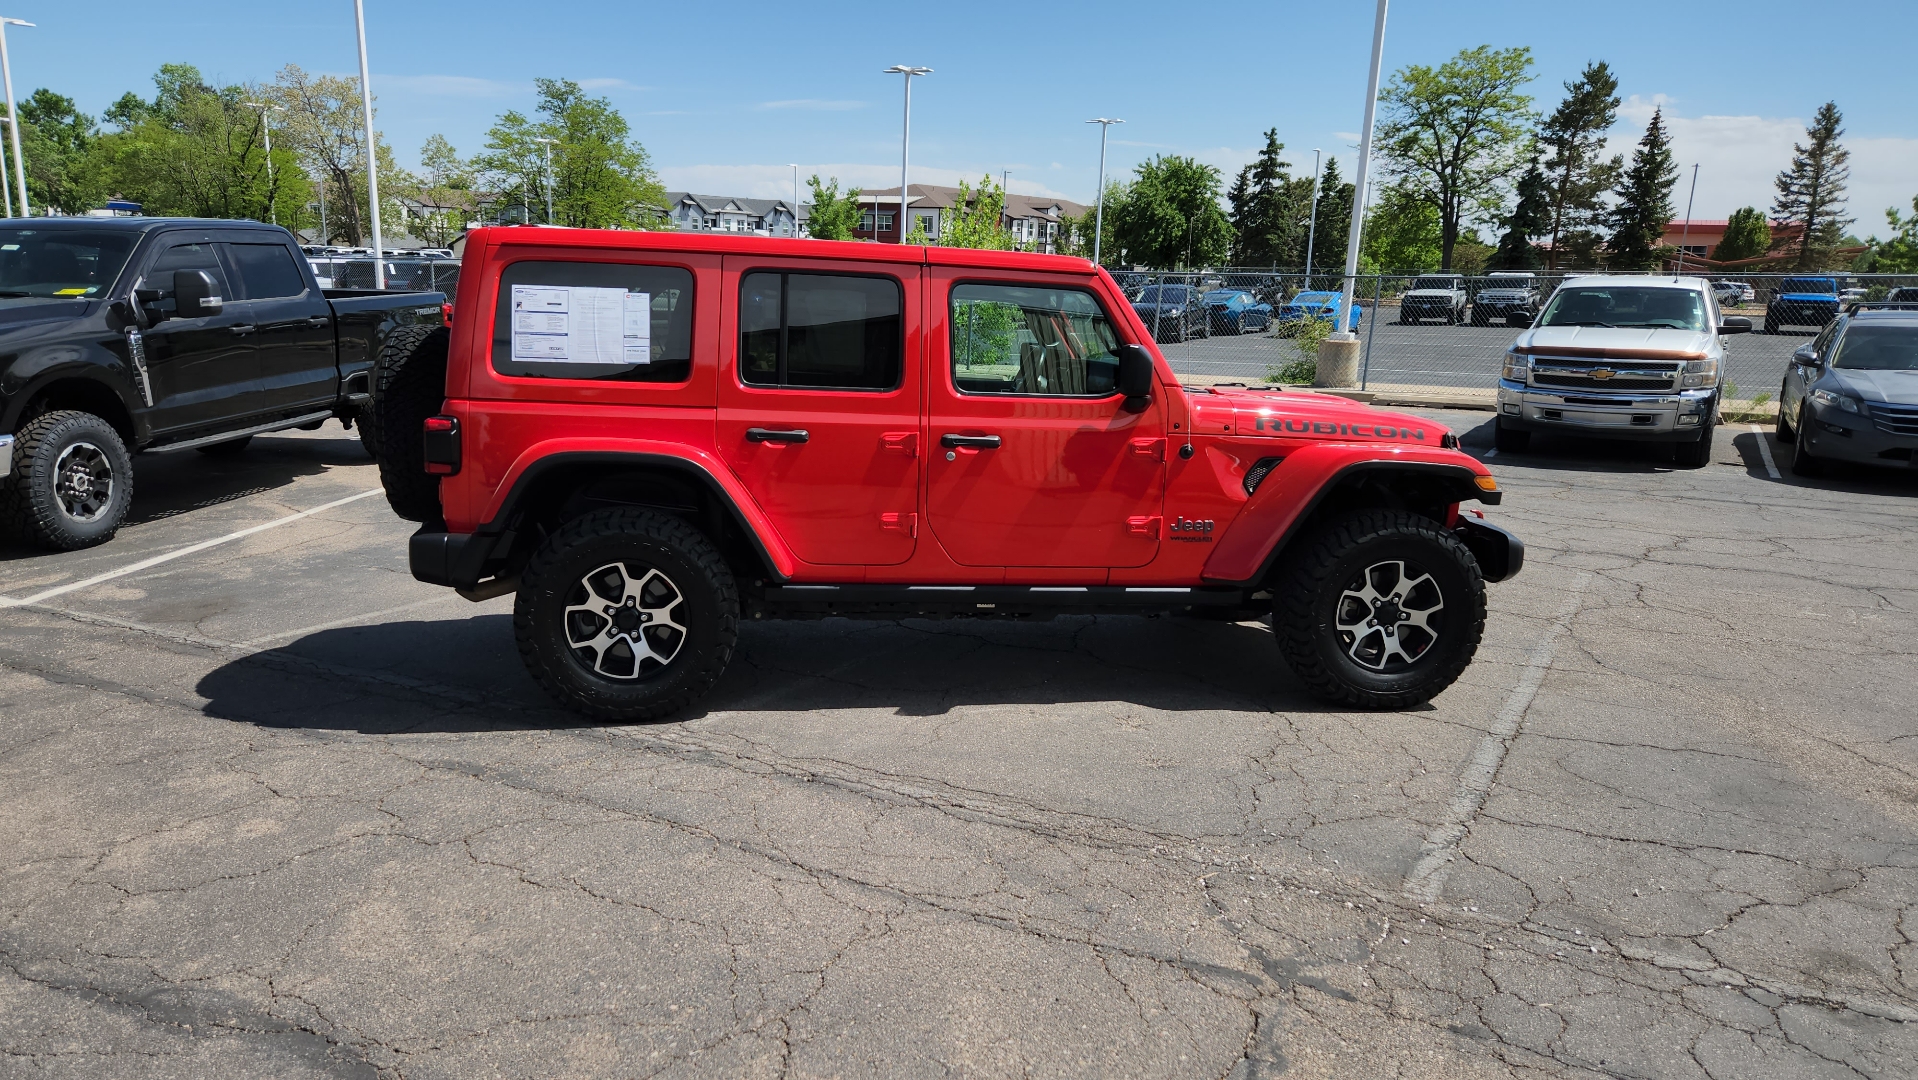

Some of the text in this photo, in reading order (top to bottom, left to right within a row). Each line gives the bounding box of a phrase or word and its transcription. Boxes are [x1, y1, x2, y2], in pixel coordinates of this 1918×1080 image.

[414, 306, 441, 316] TREMOR
[1255, 417, 1425, 440] RUBICON
[1170, 515, 1215, 535] Jeep
